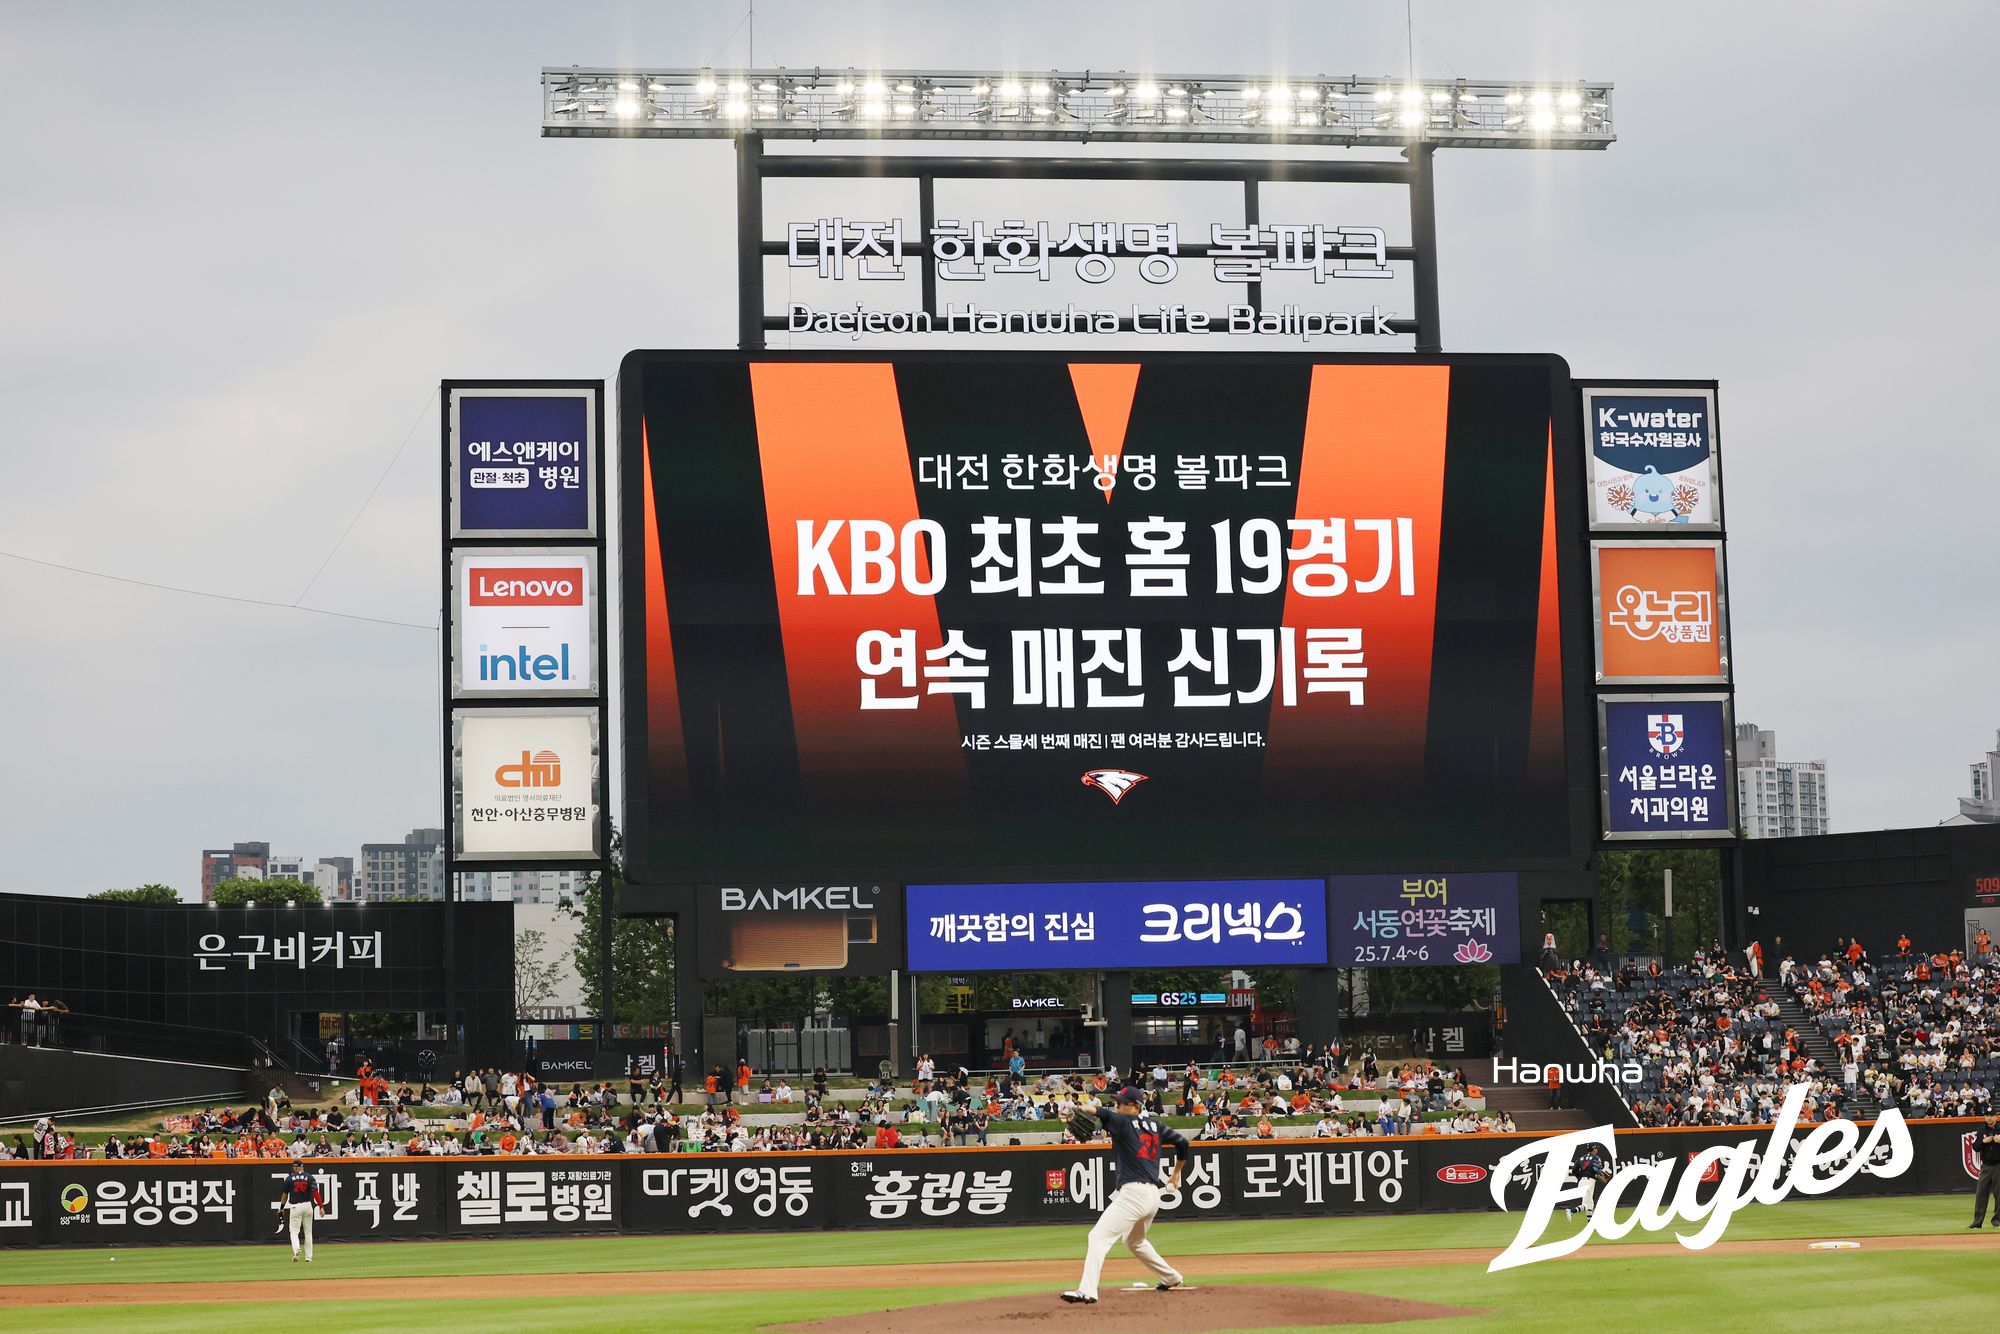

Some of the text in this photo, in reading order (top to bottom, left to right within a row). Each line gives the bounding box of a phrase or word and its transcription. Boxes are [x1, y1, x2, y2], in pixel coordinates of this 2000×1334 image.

[788, 217, 1394, 284] 대전 한화생명 볼파크
[788, 301, 1397, 342] Daejeon Hanwha Life Ballpark
[1599, 407, 1703, 428] K-water
[468, 441, 579, 465] 에스앤케이
[1600, 431, 1702, 448] 한국수자원공사
[538, 466, 580, 490] 병원
[918, 453, 1292, 491] 대전 한화생명 볼파크
[795, 515, 1416, 598] KBO 최초 홈 19경기
[479, 576, 573, 597] Lenovo
[1664, 624, 1709, 641] 상품권
[480, 643, 569, 681] intel
[855, 627, 1369, 710] 연속 매진 신기록
[961, 733, 990, 750] 시즌
[994, 733, 1038, 750] 스물세
[1041, 733, 1070, 750] 번째
[1073, 733, 1102, 749] 매진
[1110, 733, 1126, 749] 팬
[1129, 733, 1172, 748] 여러분
[1176, 732, 1266, 748] 감사드립니다.
[1648, 746, 1685, 759] BROWN
[1618, 763, 1717, 790] 서울브라운
[471, 807, 586, 822] 천안·아산충무병원
[1630, 796, 1709, 822] 치과의원
[721, 886, 874, 911] BAMKEL
[1400, 878, 1448, 906] 부여
[1975, 877, 2000, 893] 509
[929, 911, 1095, 943] 깨끗함의 진심
[1140, 902, 1306, 943] 크리넥스
[1353, 907, 1497, 940] 서동연꽃축제
[193, 930, 382, 971] 은구비커피
[1355, 945, 1430, 963] 25.7.4~6
[1012, 997, 1064, 1008] BAMKEL
[1160, 992, 1197, 1006] GS25
[541, 1060, 592, 1070] BAMKEL
[1070, 1153, 1222, 1211] 예정성
[1243, 1150, 1409, 1204] 로제비앙
[94, 1180, 236, 1225] 음성명작
[457, 1171, 612, 1225] 첼로 병원
[865, 1170, 1013, 1219] 홈런볼
